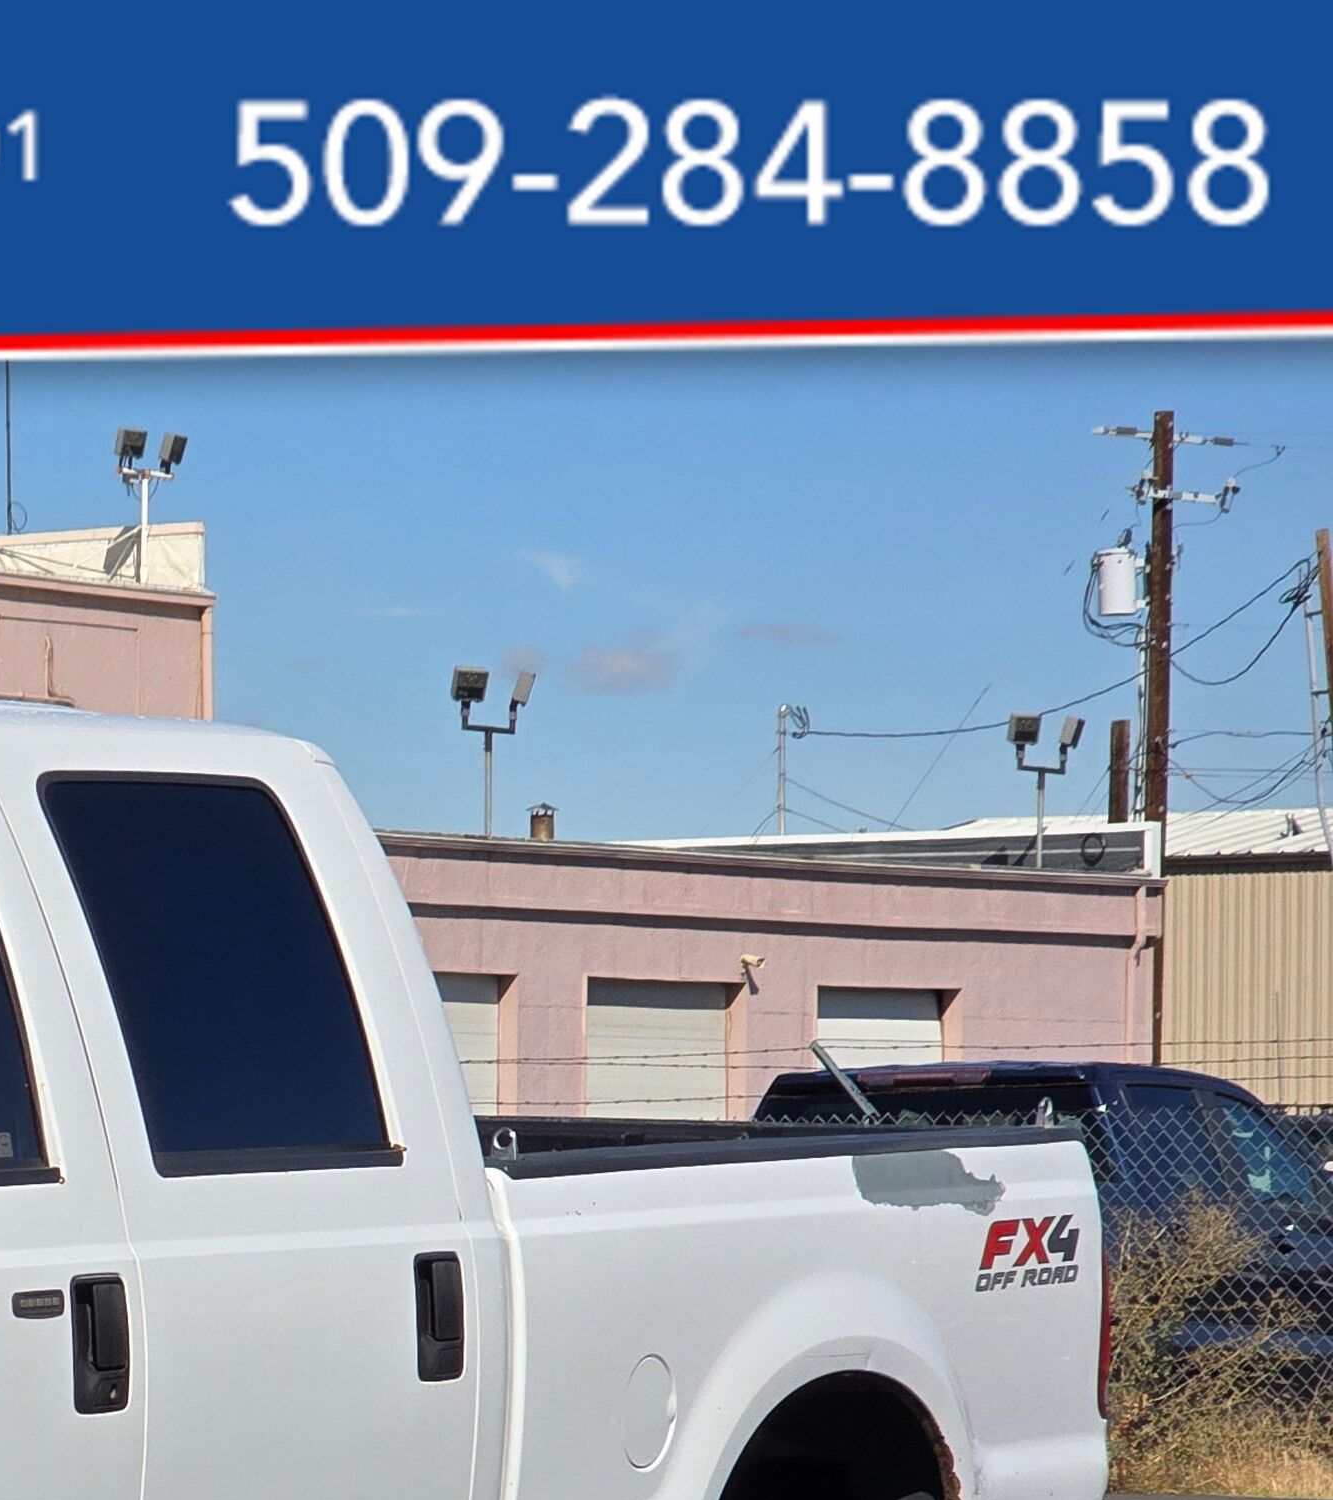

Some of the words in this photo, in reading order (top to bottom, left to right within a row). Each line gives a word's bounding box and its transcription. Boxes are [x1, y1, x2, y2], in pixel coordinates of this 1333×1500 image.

[979, 1214, 1080, 1271] FX4
[975, 1271, 1018, 1292] OFF
[1021, 1265, 1079, 1288] ROAD
